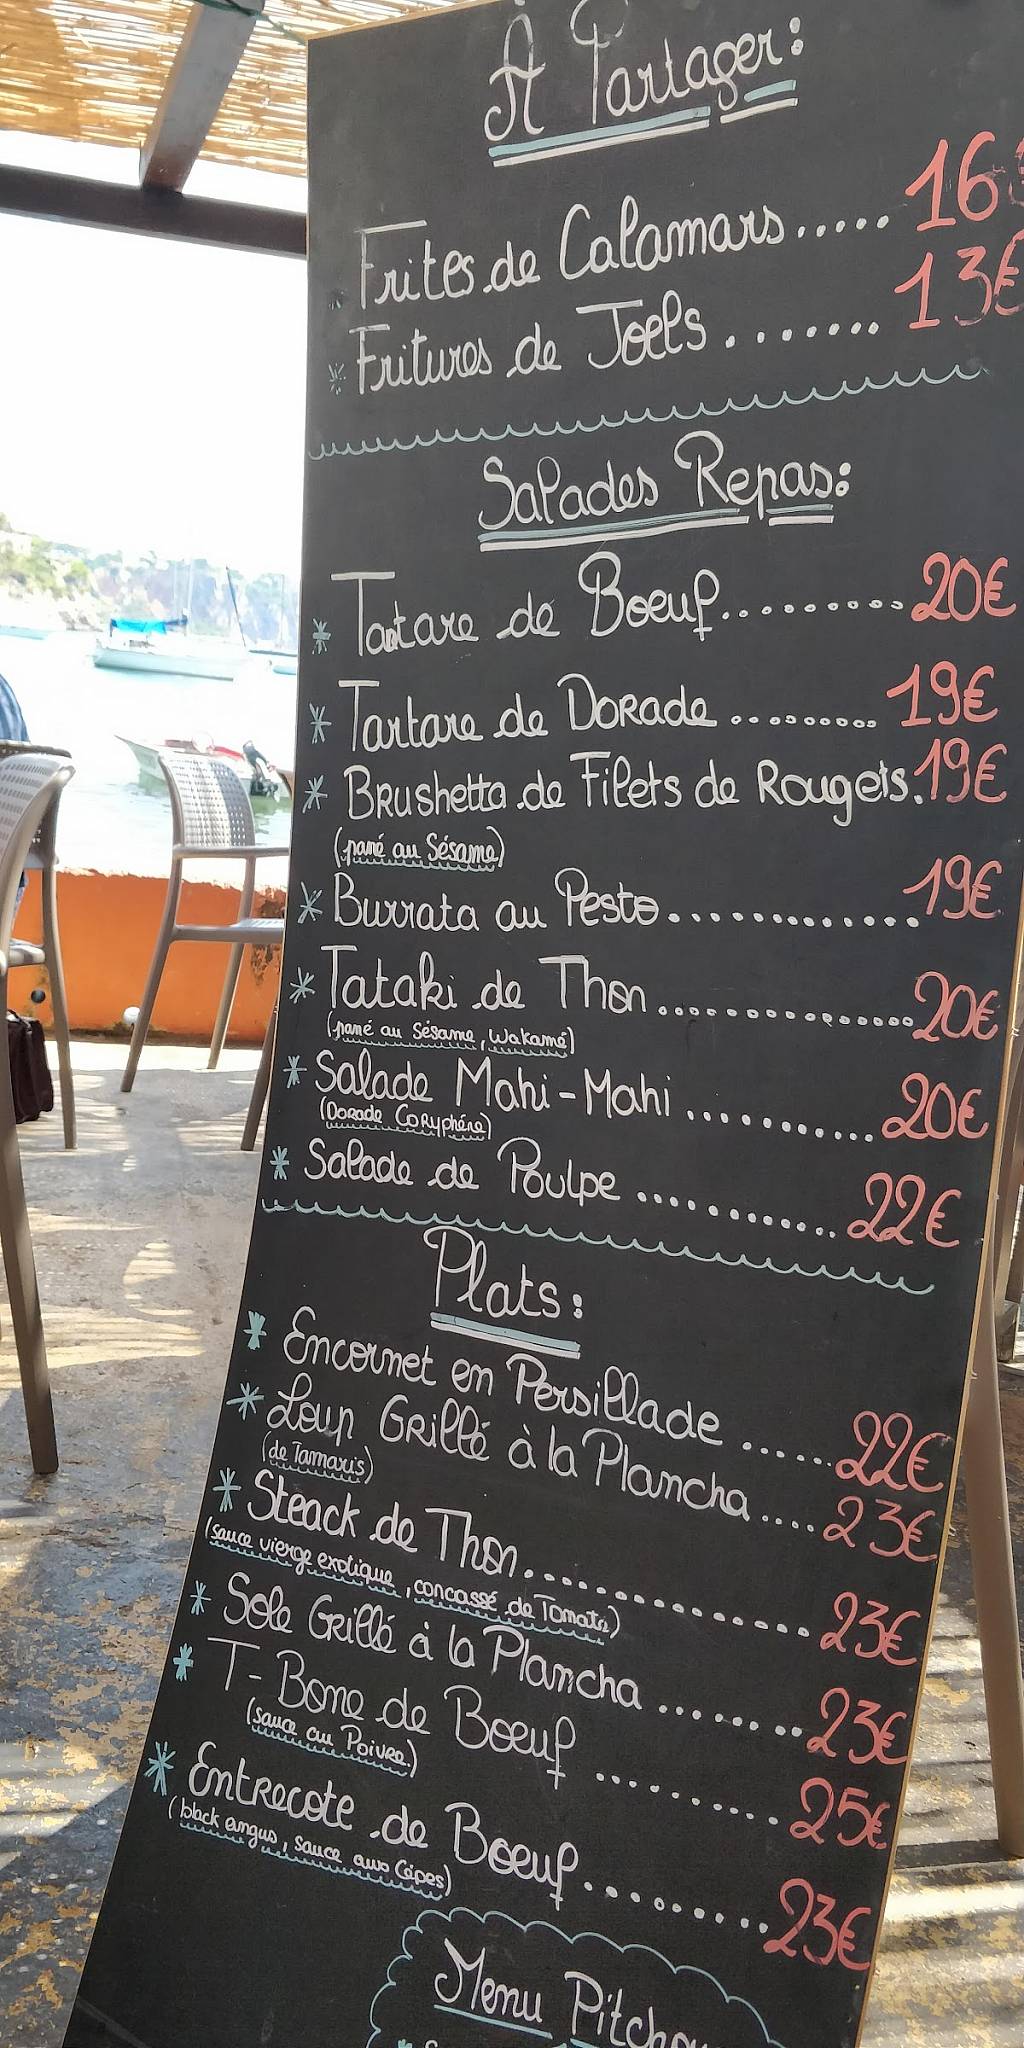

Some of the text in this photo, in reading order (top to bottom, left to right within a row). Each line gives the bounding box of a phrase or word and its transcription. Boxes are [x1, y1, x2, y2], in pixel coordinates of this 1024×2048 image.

[354, 220, 475, 310] Frites
[483, 241, 541, 293] de
[349, 323, 492, 394] Fritures
[506, 322, 562, 375] de
[478, 455, 660, 530] Salades
[496, 590, 560, 639] de
[911, 552, 1017, 621] 20€
[338, 680, 484, 752] Tartare
[493, 692, 549, 739] de
[886, 660, 998, 727] 19€
[516, 769, 567, 812] de
[569, 751, 683, 809] Filets
[694, 759, 741, 808] de
[913, 737, 1008, 803] 19€
[334, 872, 480, 932] Burrata
[495, 899, 547, 931] au
[903, 854, 1003, 920] 19€
[392, 841, 422, 859] au
[320, 945, 458, 1011] Tataki
[471, 968, 526, 1010] de
[911, 971, 999, 1042] 20€
[379, 1025, 402, 1039] au
[315, 1048, 434, 1102] Salade
[881, 1071, 989, 1140] 20€
[304, 1137, 414, 1186] Salade
[428, 1156, 480, 1190] de
[846, 1172, 962, 1248] 22€
[283, 1306, 952, 1493] Encornet en Persillade 22€
[266, 1372, 355, 1447] Loup
[508, 1423, 537, 1470] à
[548, 1424, 579, 1478] la
[581, 1427, 751, 1522] Plancha
[823, 1495, 938, 1563] 23€
[247, 1468, 361, 1538] Steack
[368, 1501, 419, 1553] de
[819, 1591, 921, 1667] 23€
[259, 1537, 313, 1576] vierge
[504, 1595, 536, 1620] de
[223, 1571, 294, 1634] Sole
[448, 1624, 476, 1668] la
[482, 1624, 643, 1710] Plancha
[806, 1687, 913, 1766] 23€
[305, 1726, 334, 1747] au
[375, 1687, 432, 1735] de
[789, 1777, 891, 1850] 25€
[294, 1836, 343, 1864] sauce
[369, 1804, 430, 1849] de
[763, 1877, 872, 1971] 23€
[434, 1938, 544, 2024] Menu
